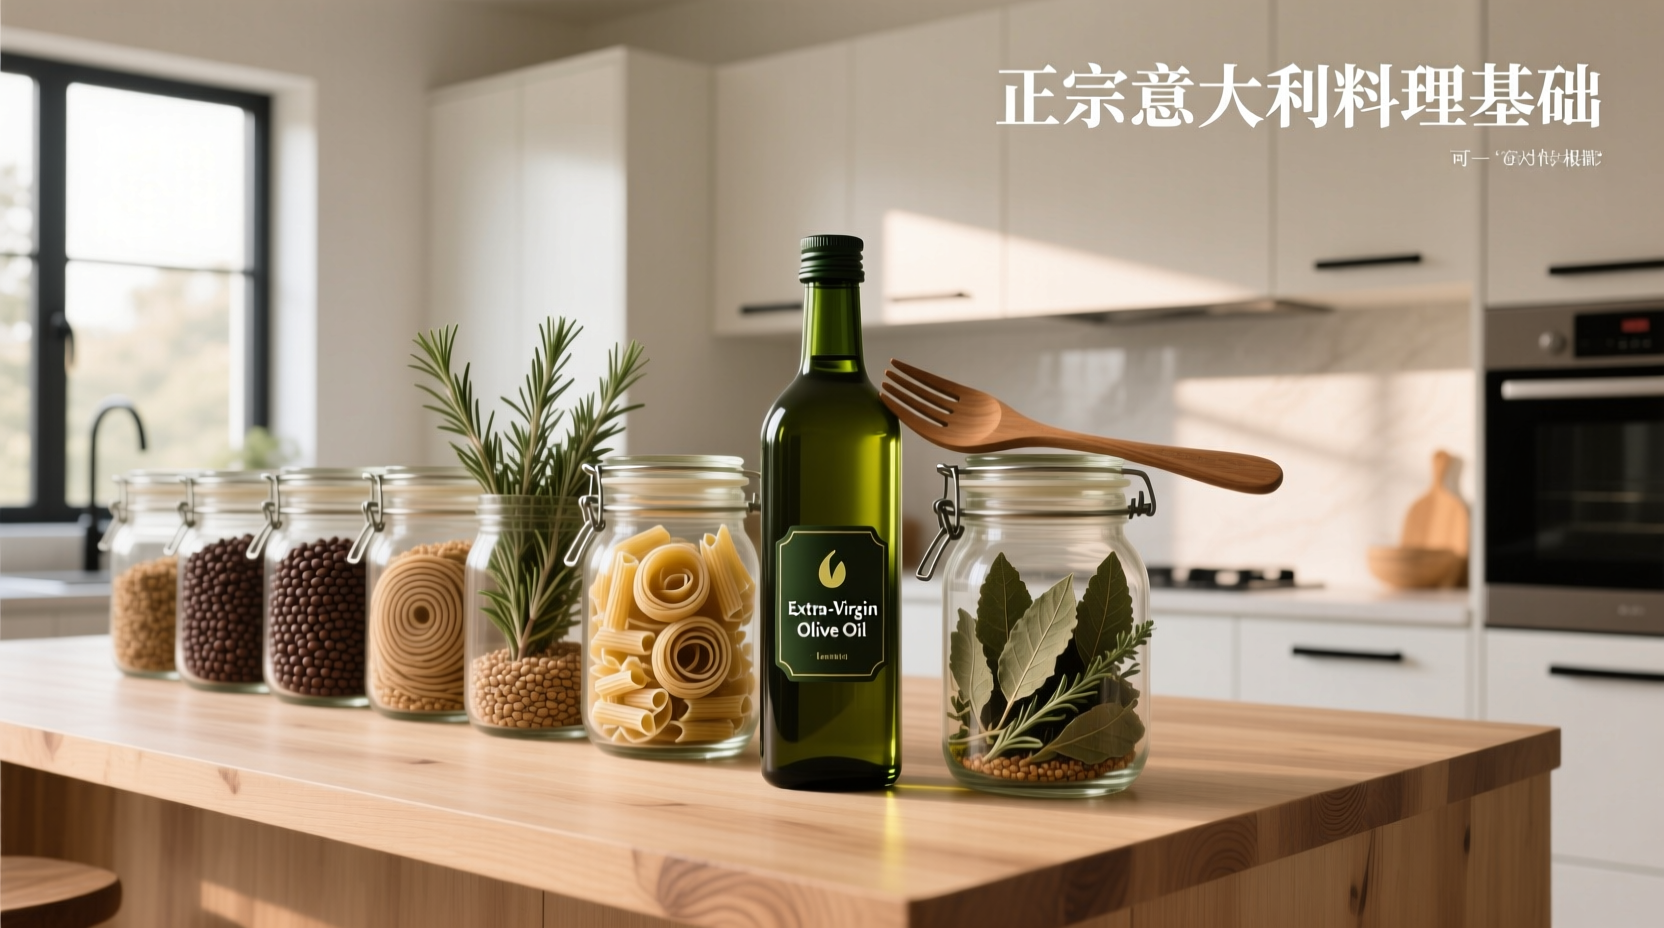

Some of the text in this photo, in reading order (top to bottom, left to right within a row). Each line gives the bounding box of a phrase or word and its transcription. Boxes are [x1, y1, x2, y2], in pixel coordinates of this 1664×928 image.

[788, 600, 878, 620] Extra-Virgin
[797, 621, 867, 638] Olive Oil
